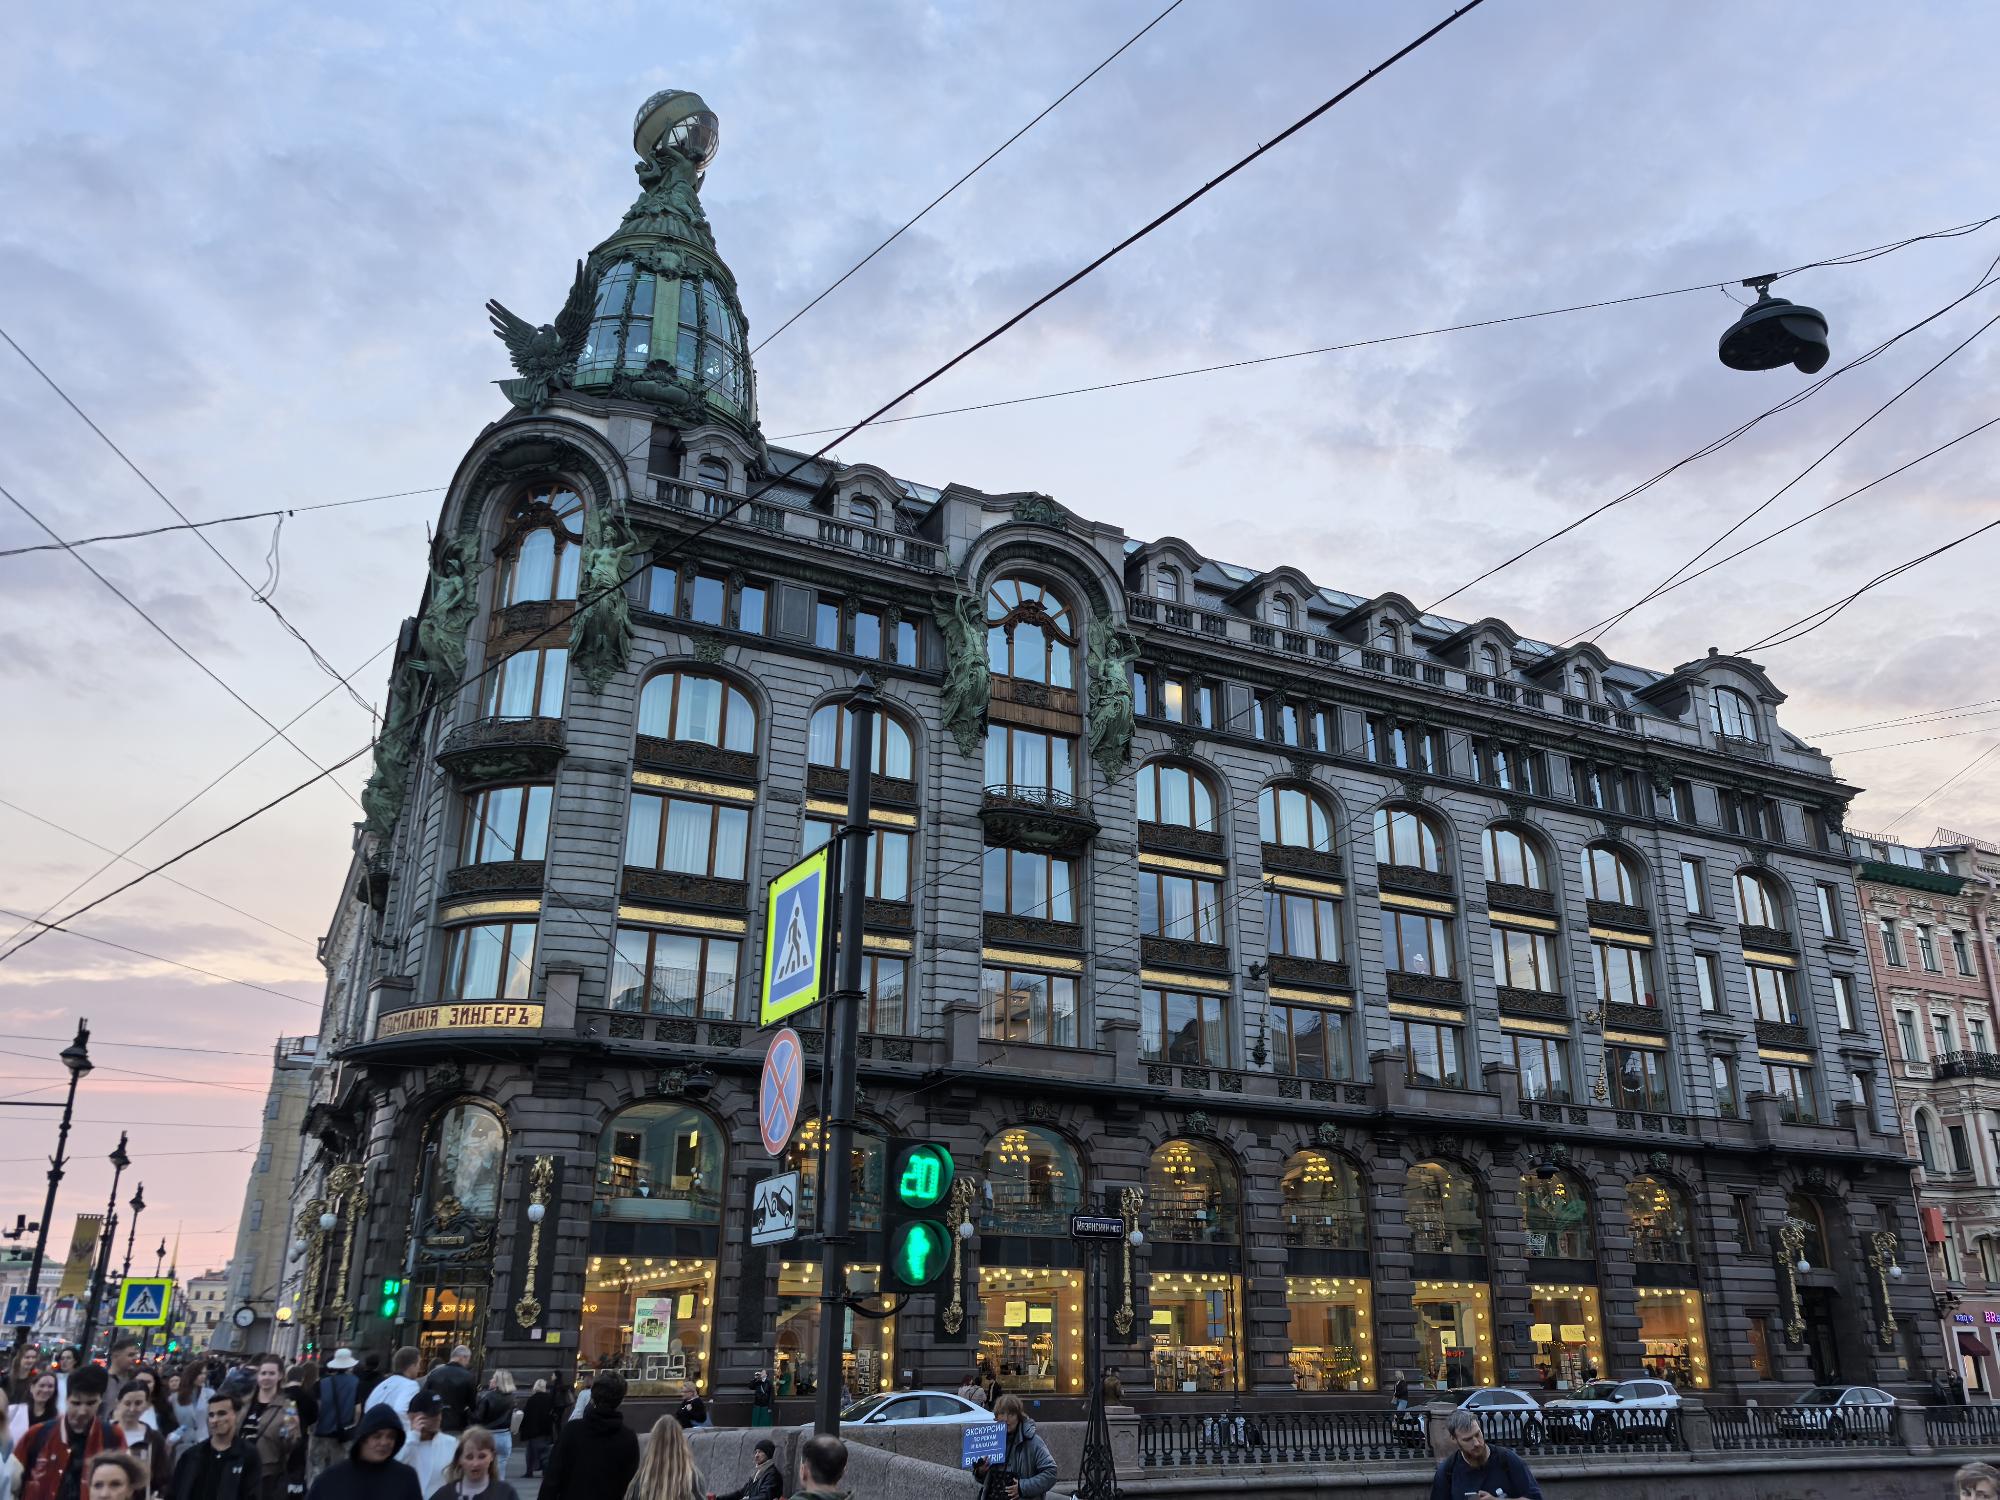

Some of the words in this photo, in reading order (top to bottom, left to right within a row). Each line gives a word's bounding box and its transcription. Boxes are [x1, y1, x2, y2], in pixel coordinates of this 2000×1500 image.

[450, 1006, 529, 1026] ЗИНГЕРЪ
[900, 1154, 940, 1199] 20
[965, 1423, 1006, 1437] ЭКСКУРСИИ
[965, 1454, 985, 1466] BOA
